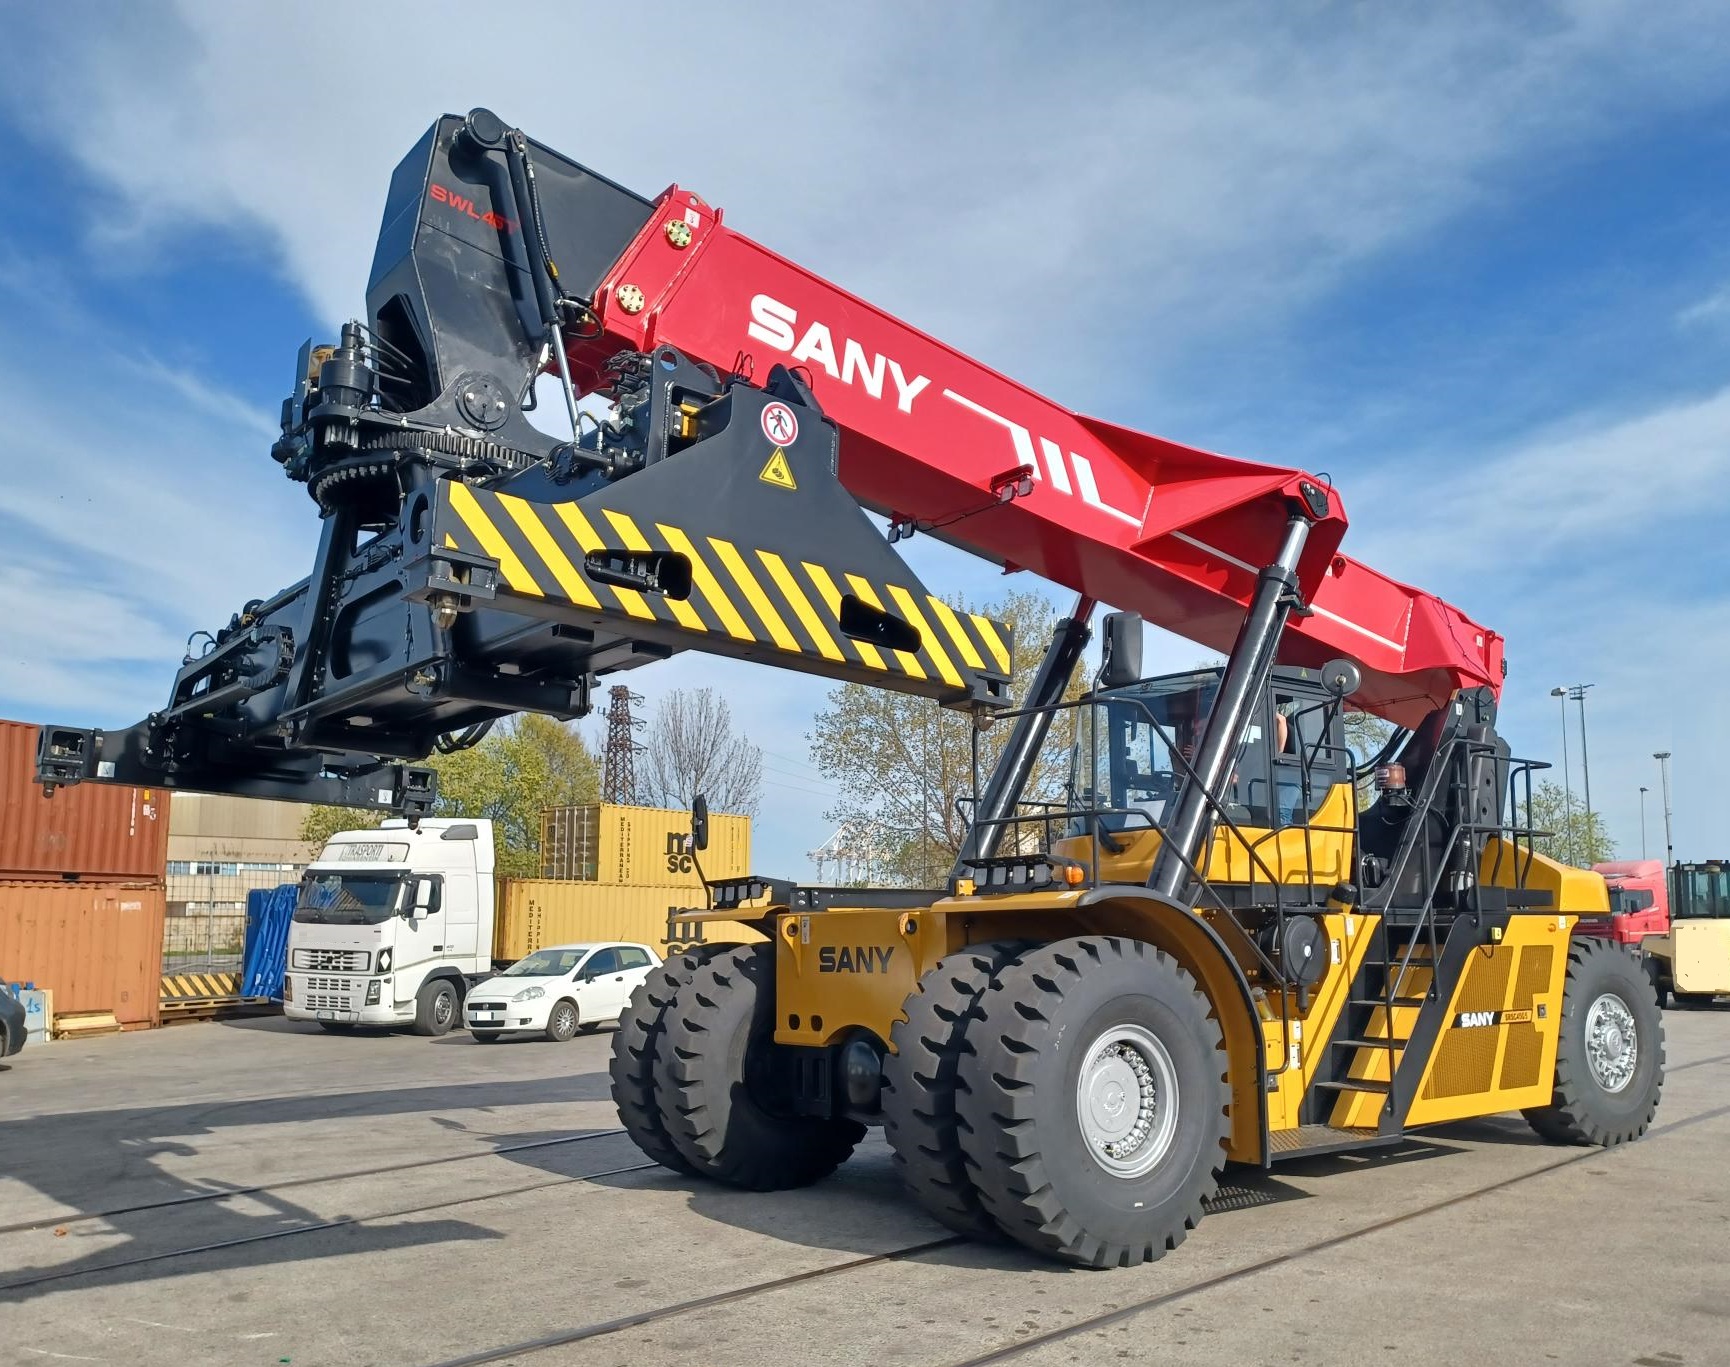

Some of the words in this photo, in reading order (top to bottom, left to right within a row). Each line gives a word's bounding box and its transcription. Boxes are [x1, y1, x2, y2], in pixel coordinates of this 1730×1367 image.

[748, 294, 932, 415] SANY
[527, 899, 535, 955] MEDITERRA
[818, 946, 895, 974] SANY
[1461, 1011, 1495, 1028] SANY
